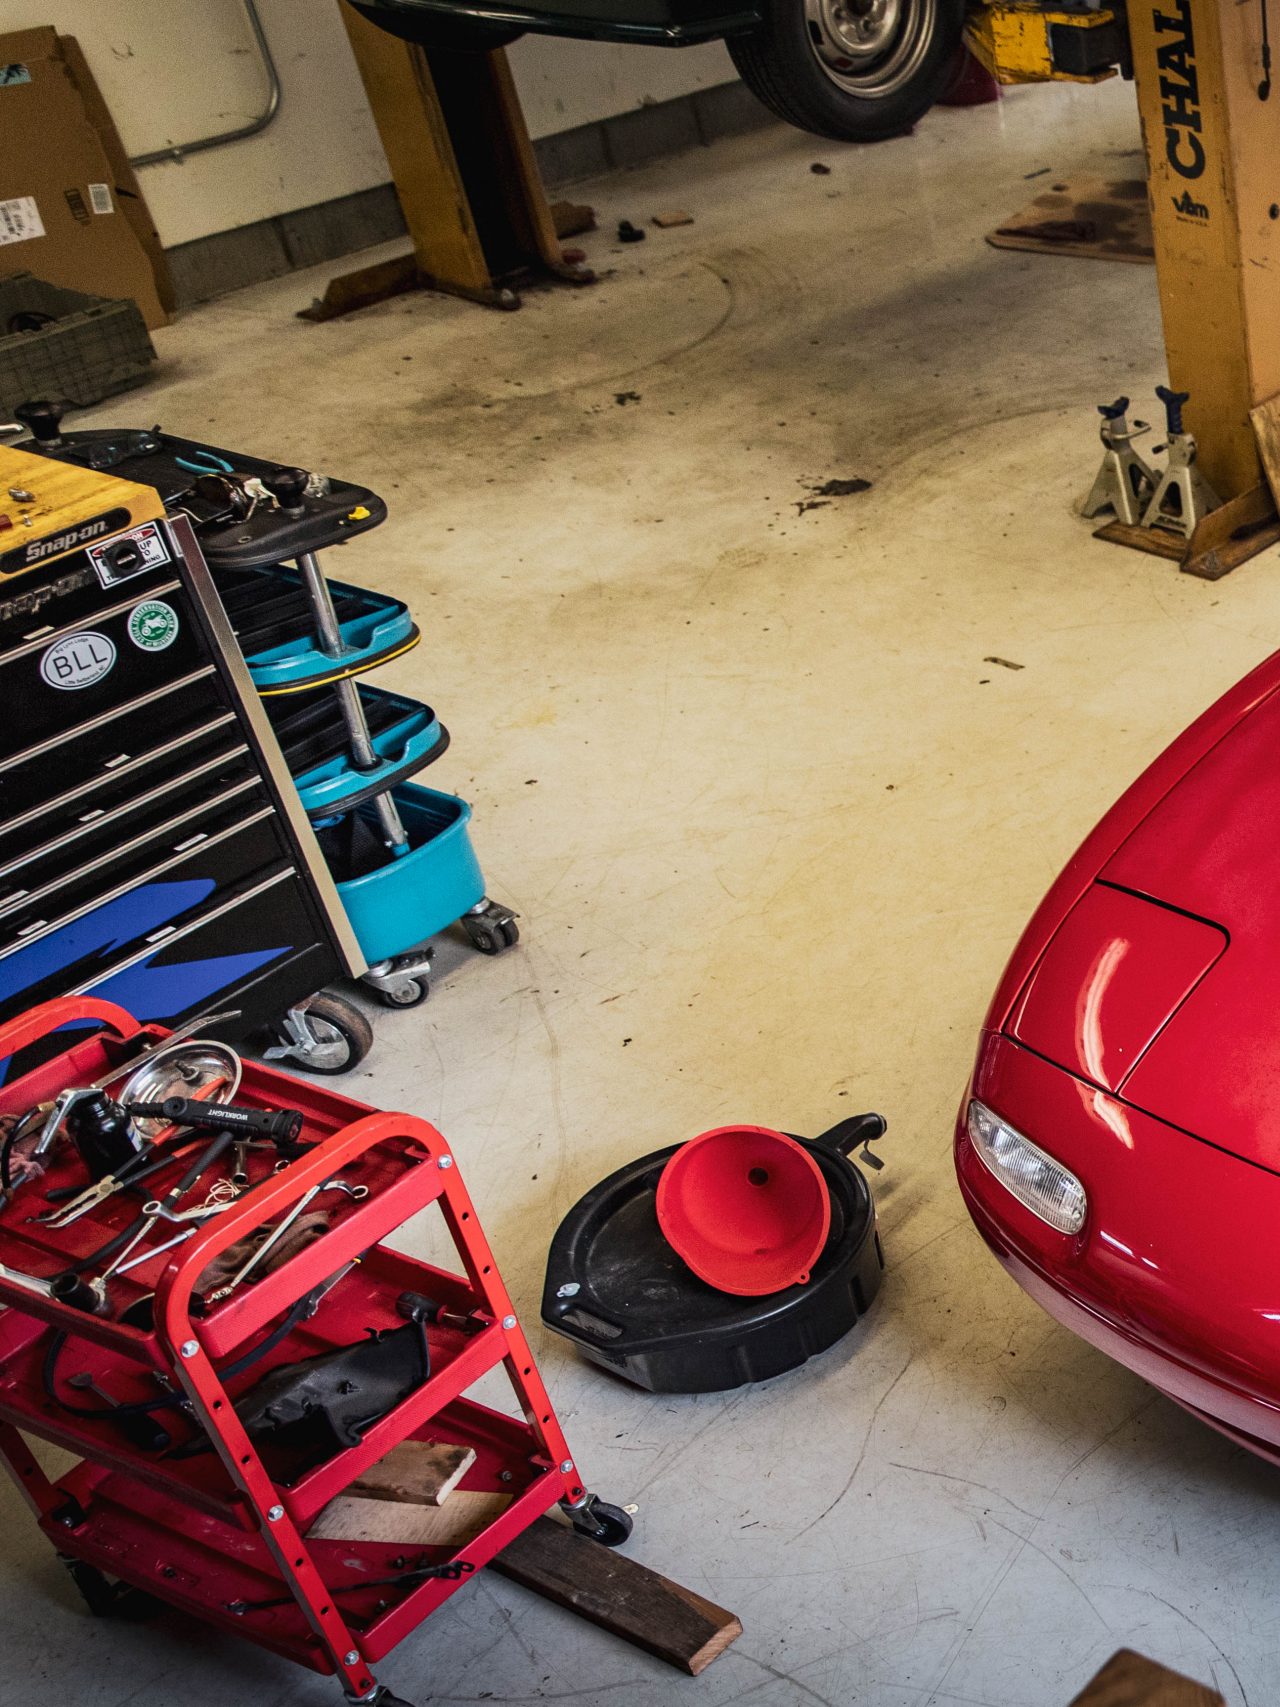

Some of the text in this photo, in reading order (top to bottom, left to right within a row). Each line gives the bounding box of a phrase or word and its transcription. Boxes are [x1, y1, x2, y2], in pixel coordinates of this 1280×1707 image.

[26, 520, 107, 562] Snap-on
[52, 644, 108, 679] BLL
[208, 1108, 249, 1121] WORKLIGHT
